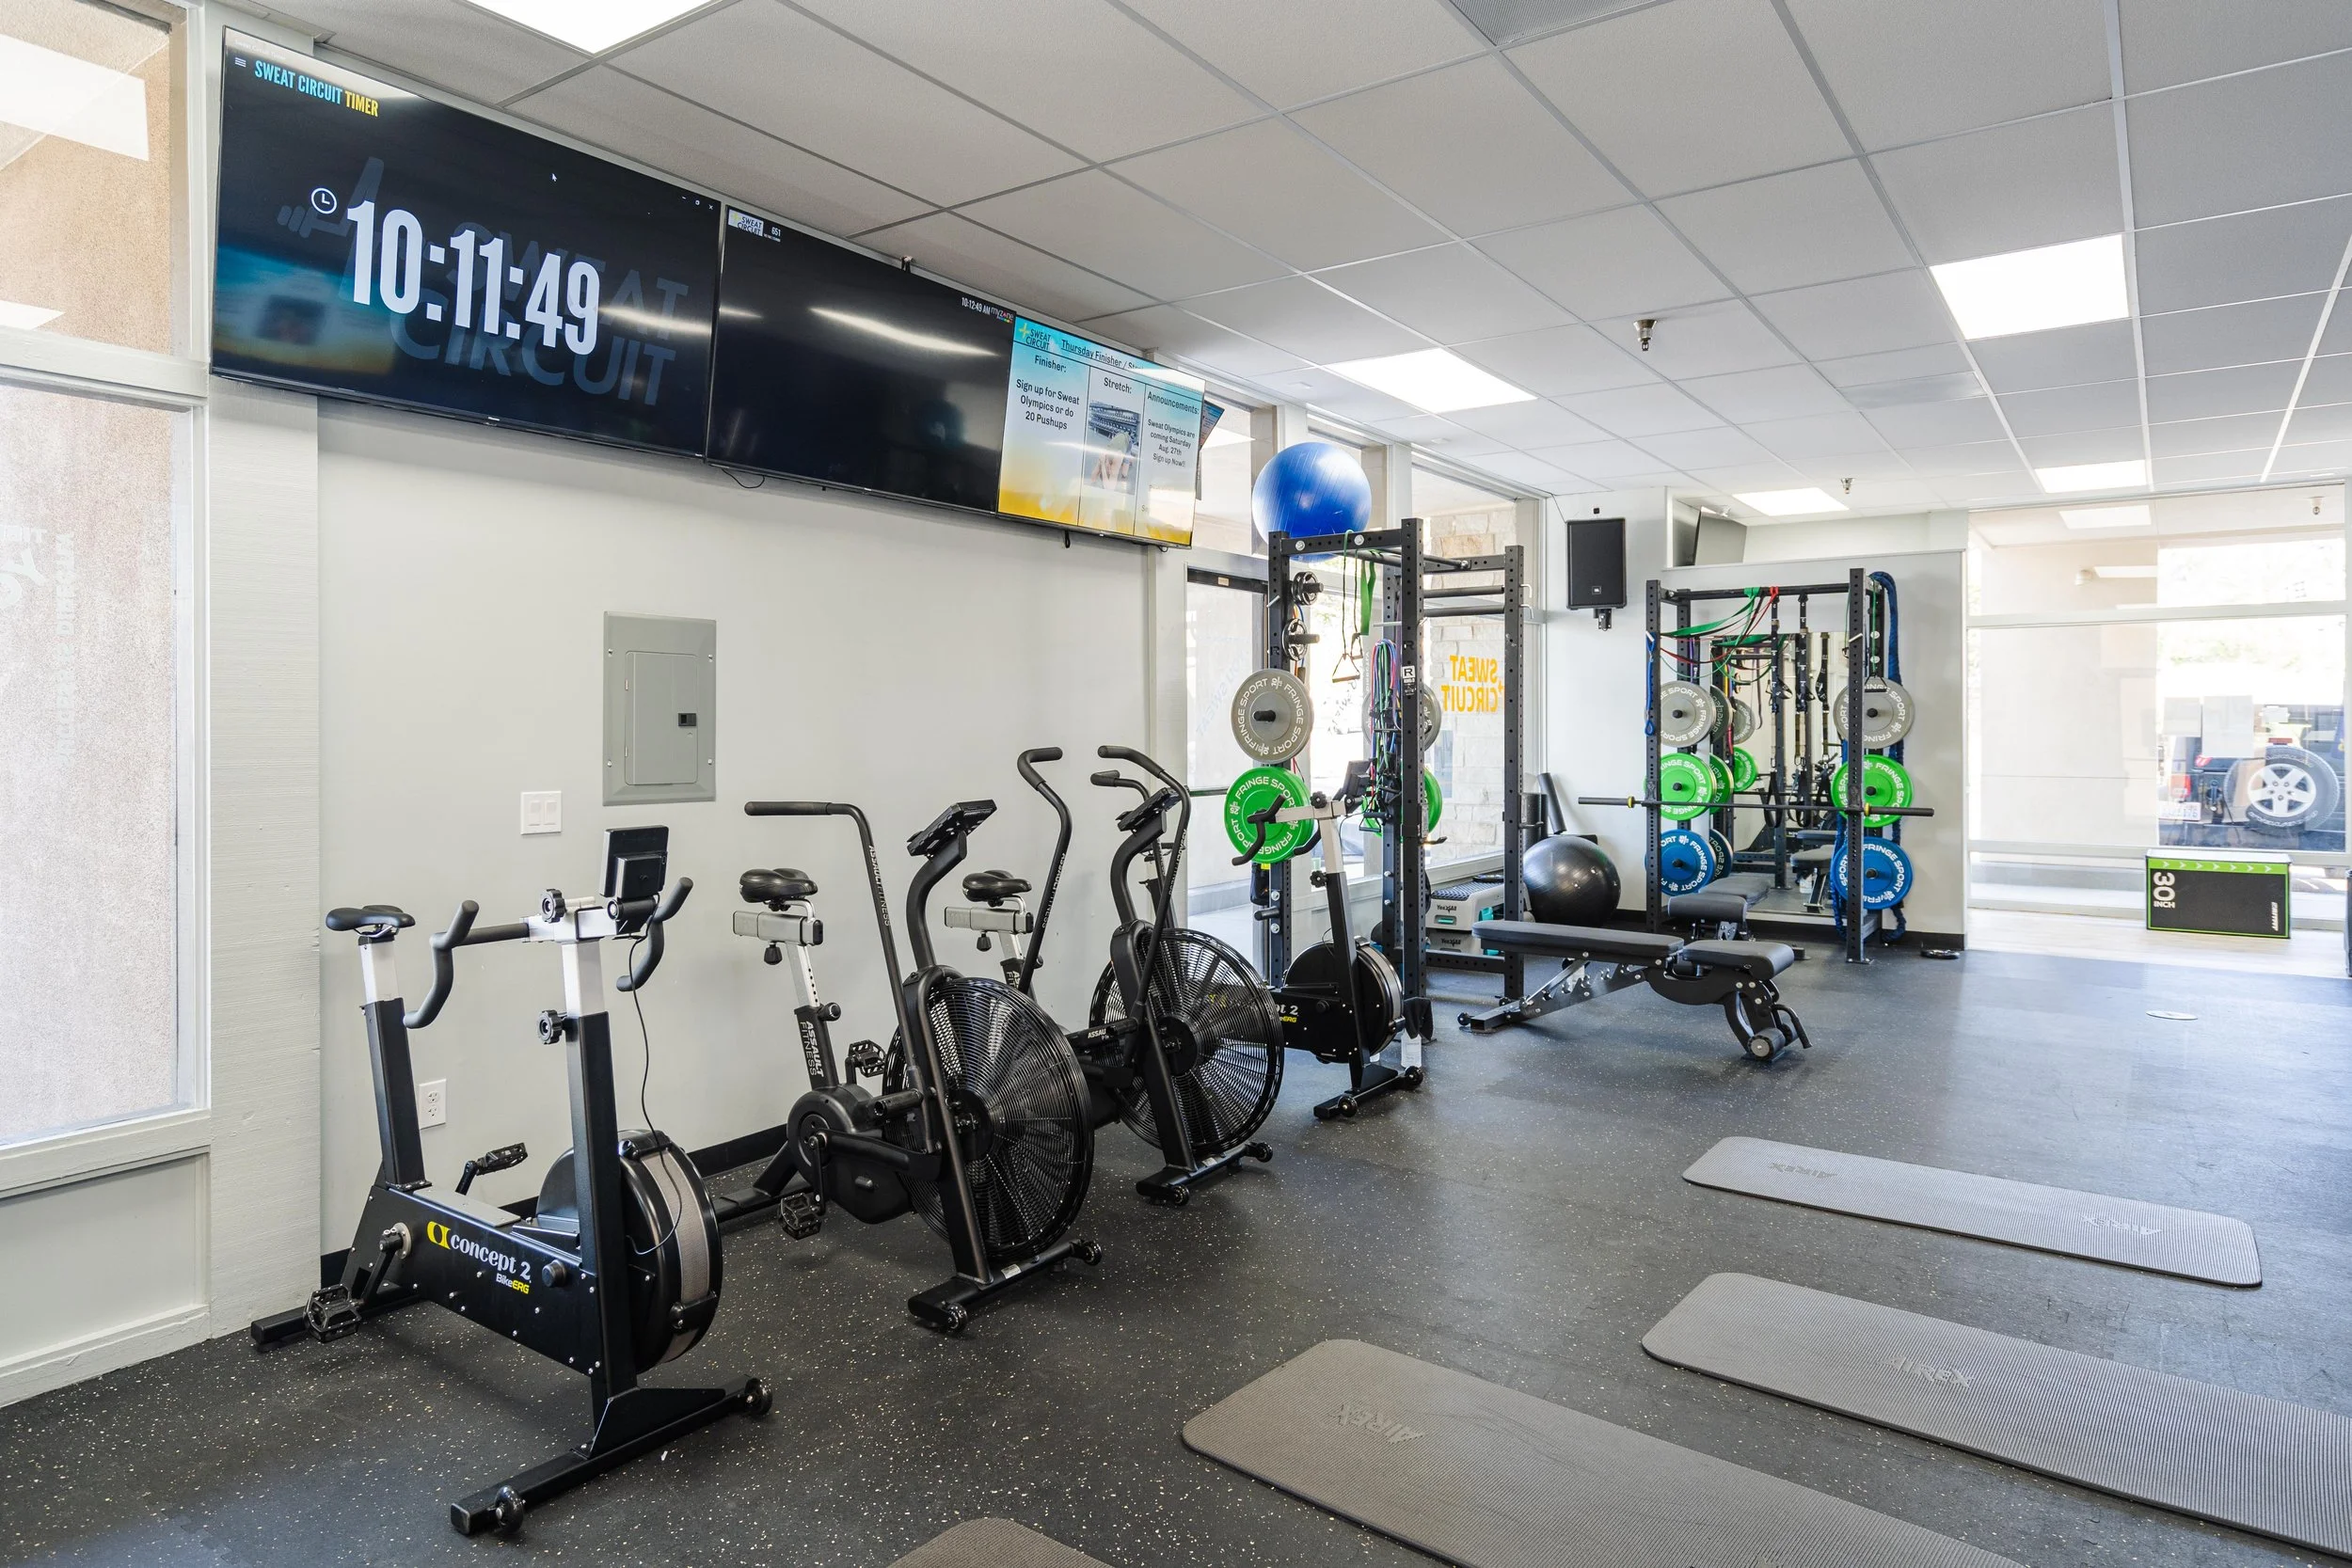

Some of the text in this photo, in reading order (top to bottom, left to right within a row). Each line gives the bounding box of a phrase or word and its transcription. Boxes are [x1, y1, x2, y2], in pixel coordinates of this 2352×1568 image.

[255, 60, 379, 118] SWEAT CIRCUIT TIMER
[742, 216, 762, 229] SWEAT
[347, 200, 600, 356] 10:11:49
[982, 305, 991, 316] AM
[1025, 336, 1050, 351] CIRCUIT
[1030, 329, 1051, 342] SWEAT
[1035, 356, 1067, 372] Finisher:
[1061, 340, 1094, 360] Thursday
[1095, 351, 1122, 367] Finisher
[1016, 379, 1080, 404] Sign up for Sweat
[1104, 377, 1133, 394] Stretch:
[1021, 395, 1054, 412] Olympics
[1065, 407, 1074, 418] do
[1148, 391, 1200, 415] Announcements:
[1025, 411, 1068, 430] 20 Pushups
[1147, 419, 1196, 438] Sweat Olympics are
[1150, 432, 1191, 449] coming Saturday
[1170, 447, 1183, 455] 27th
[1152, 453, 1164, 464] Sign
[1404, 668, 1413, 677] R
[1668, 688, 1698, 698] SPORT
[1237, 677, 1268, 751] FRINGE SPORT
[1840, 705, 1849, 730] PORT
[1889, 690, 1906, 721] SPORT
[1273, 684, 1303, 755] FRINGE SPORT
[1688, 709, 1707, 737] FRINGE
[1661, 759, 1682, 770] INGE
[1683, 761, 1706, 784] SPORT
[1875, 762, 1904, 789] FRINGE
[1235, 776, 1269, 800] FRINGE
[1231, 818, 1254, 848] PORT
[1661, 836, 1677, 847] ORT
[1680, 840, 1708, 892] FRINGE SPORT
[1863, 844, 1905, 893] FRINGE SPORT
[2153, 871, 2176, 901] 30
[1290, 1005, 1298, 1015] 2
[1088, 1026, 1106, 1038] ASSAU
[800, 1022, 818, 1077] FITNESS
[805, 1021, 824, 1078] ASSAULT
[451, 1234, 532, 1280] concept 2
[496, 1274, 530, 1294] BikeERG
[1875, 1354, 1975, 1390] AIREX
[1327, 1403, 1426, 1445] AIREX
